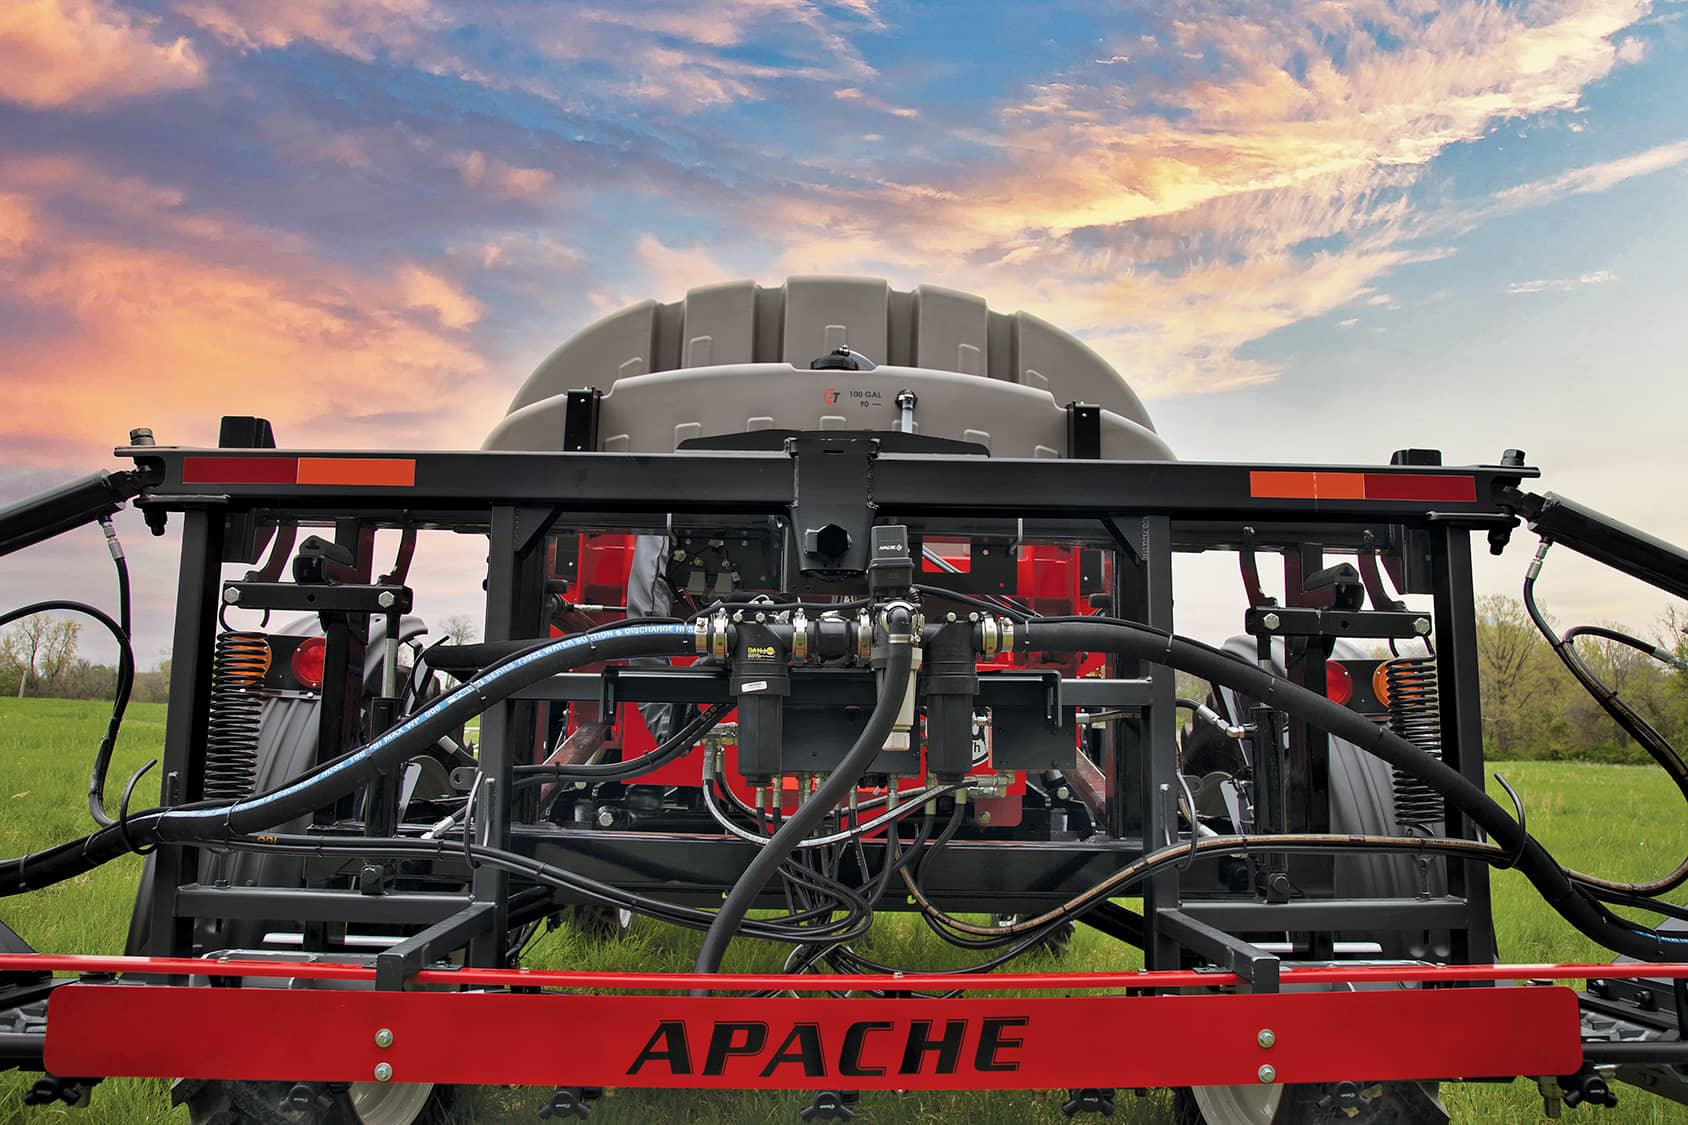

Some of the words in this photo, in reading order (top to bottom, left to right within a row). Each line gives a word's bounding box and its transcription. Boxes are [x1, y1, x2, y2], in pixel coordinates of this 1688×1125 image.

[860, 400, 870, 408] 90
[543, 638, 575, 656] WATER
[624, 624, 673, 636] DISCHARGE
[625, 1016, 1030, 1078] APACHE
